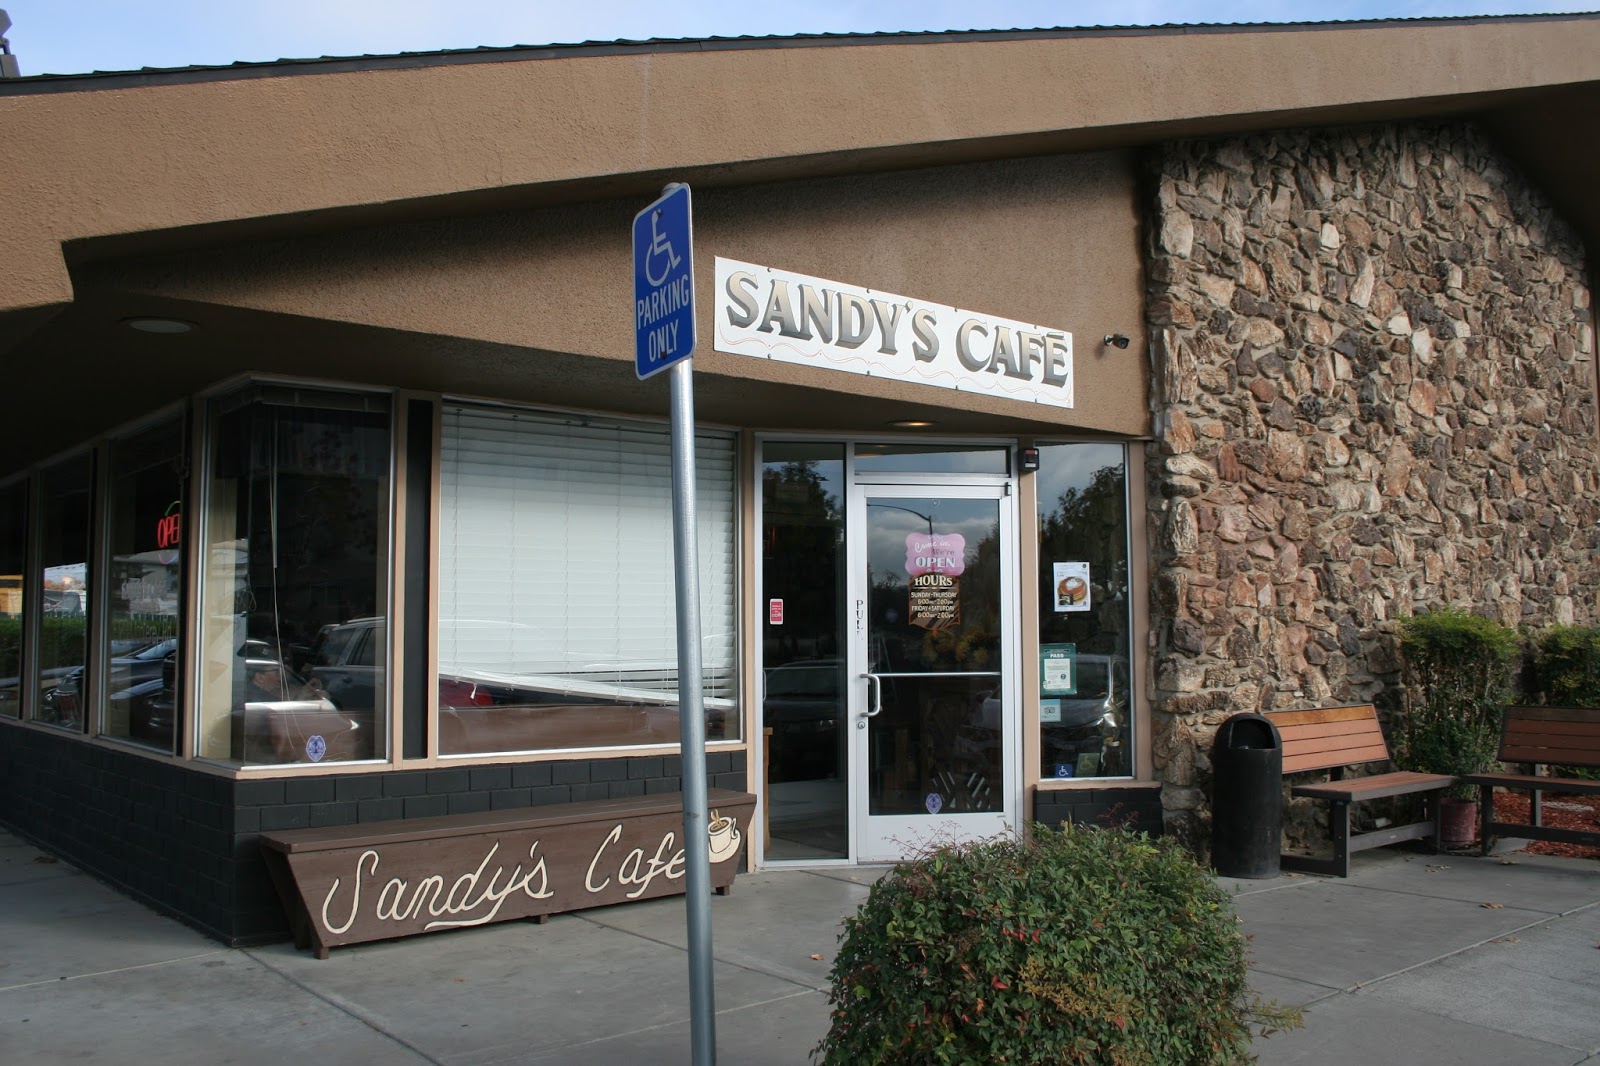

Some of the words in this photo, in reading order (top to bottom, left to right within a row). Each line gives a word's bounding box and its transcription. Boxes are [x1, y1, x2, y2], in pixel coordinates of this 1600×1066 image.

[637, 274, 690, 330] PARKING
[726, 271, 940, 363] SANDY'S
[648, 319, 679, 362] ONLY
[157, 513, 180, 549] OPE
[914, 542, 938, 553] Come
[914, 574, 953, 587] HOURS
[915, 556, 956, 568] OPEN
[322, 841, 554, 934] Sandy's
